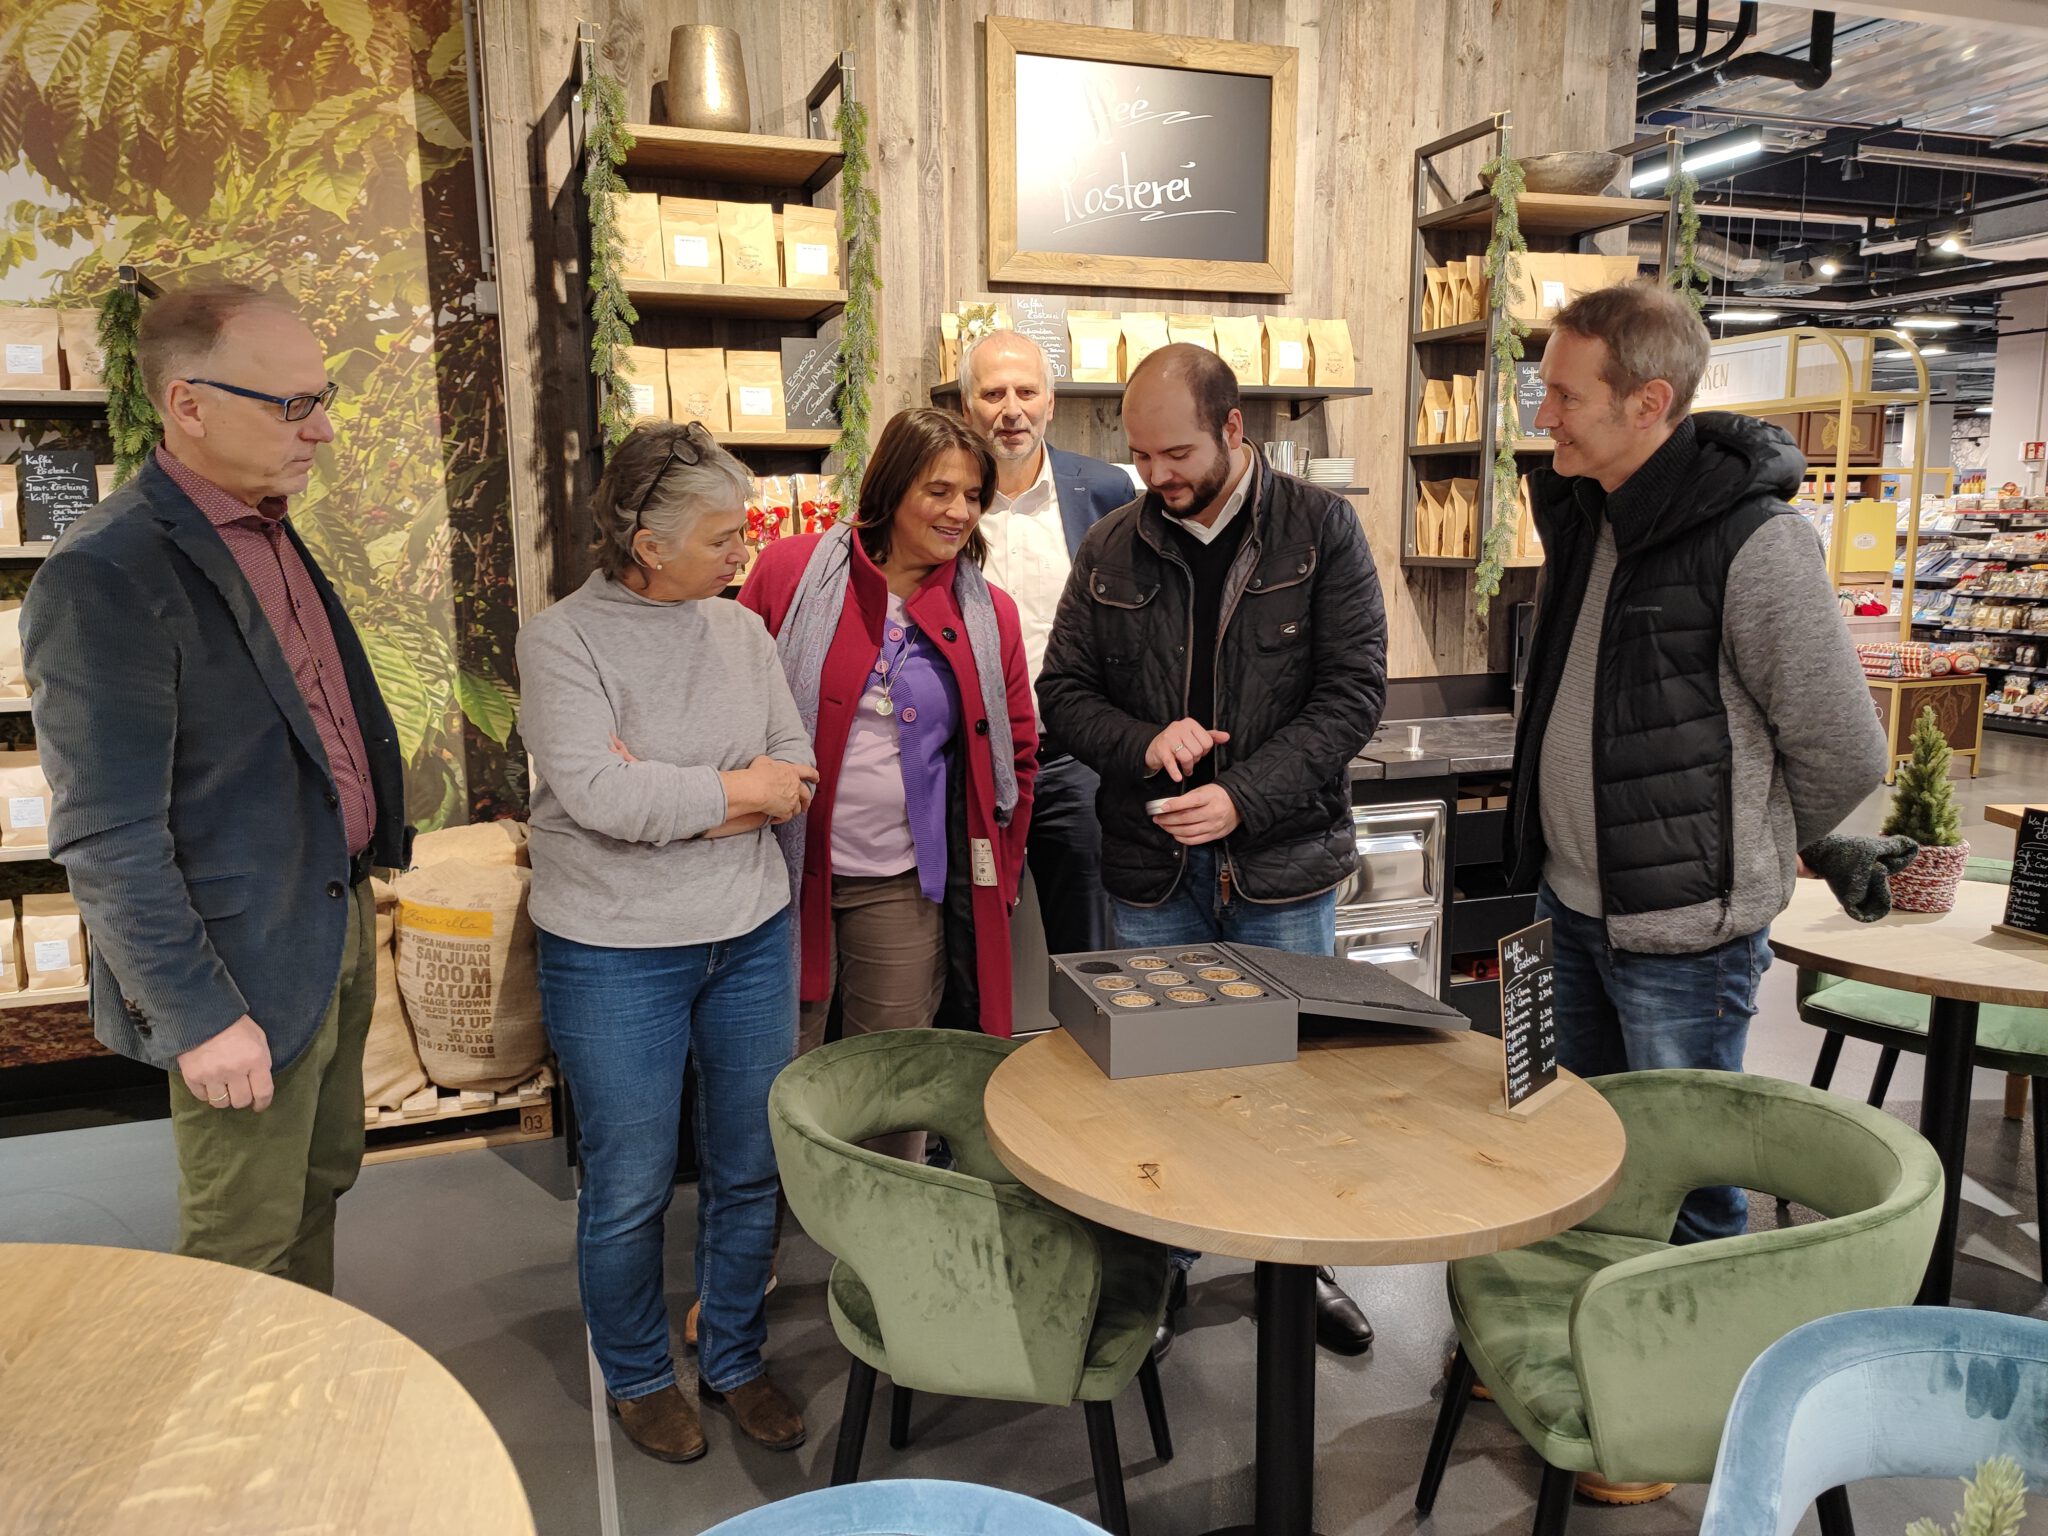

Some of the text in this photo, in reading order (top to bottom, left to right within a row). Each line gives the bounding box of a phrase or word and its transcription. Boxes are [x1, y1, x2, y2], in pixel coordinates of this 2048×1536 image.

[412, 934, 434, 948] FINCA
[435, 940, 491, 953] HAMBURGO
[416, 945, 491, 967] SAN JUAN
[415, 961, 492, 984] 1.300 M
[424, 981, 492, 999] CATUAI
[450, 999, 491, 1008] GROWN
[450, 1008, 492, 1016] NATURAL
[451, 1017, 465, 1028] 14
[470, 1016, 492, 1028] UP
[524, 1114, 543, 1131] 03
